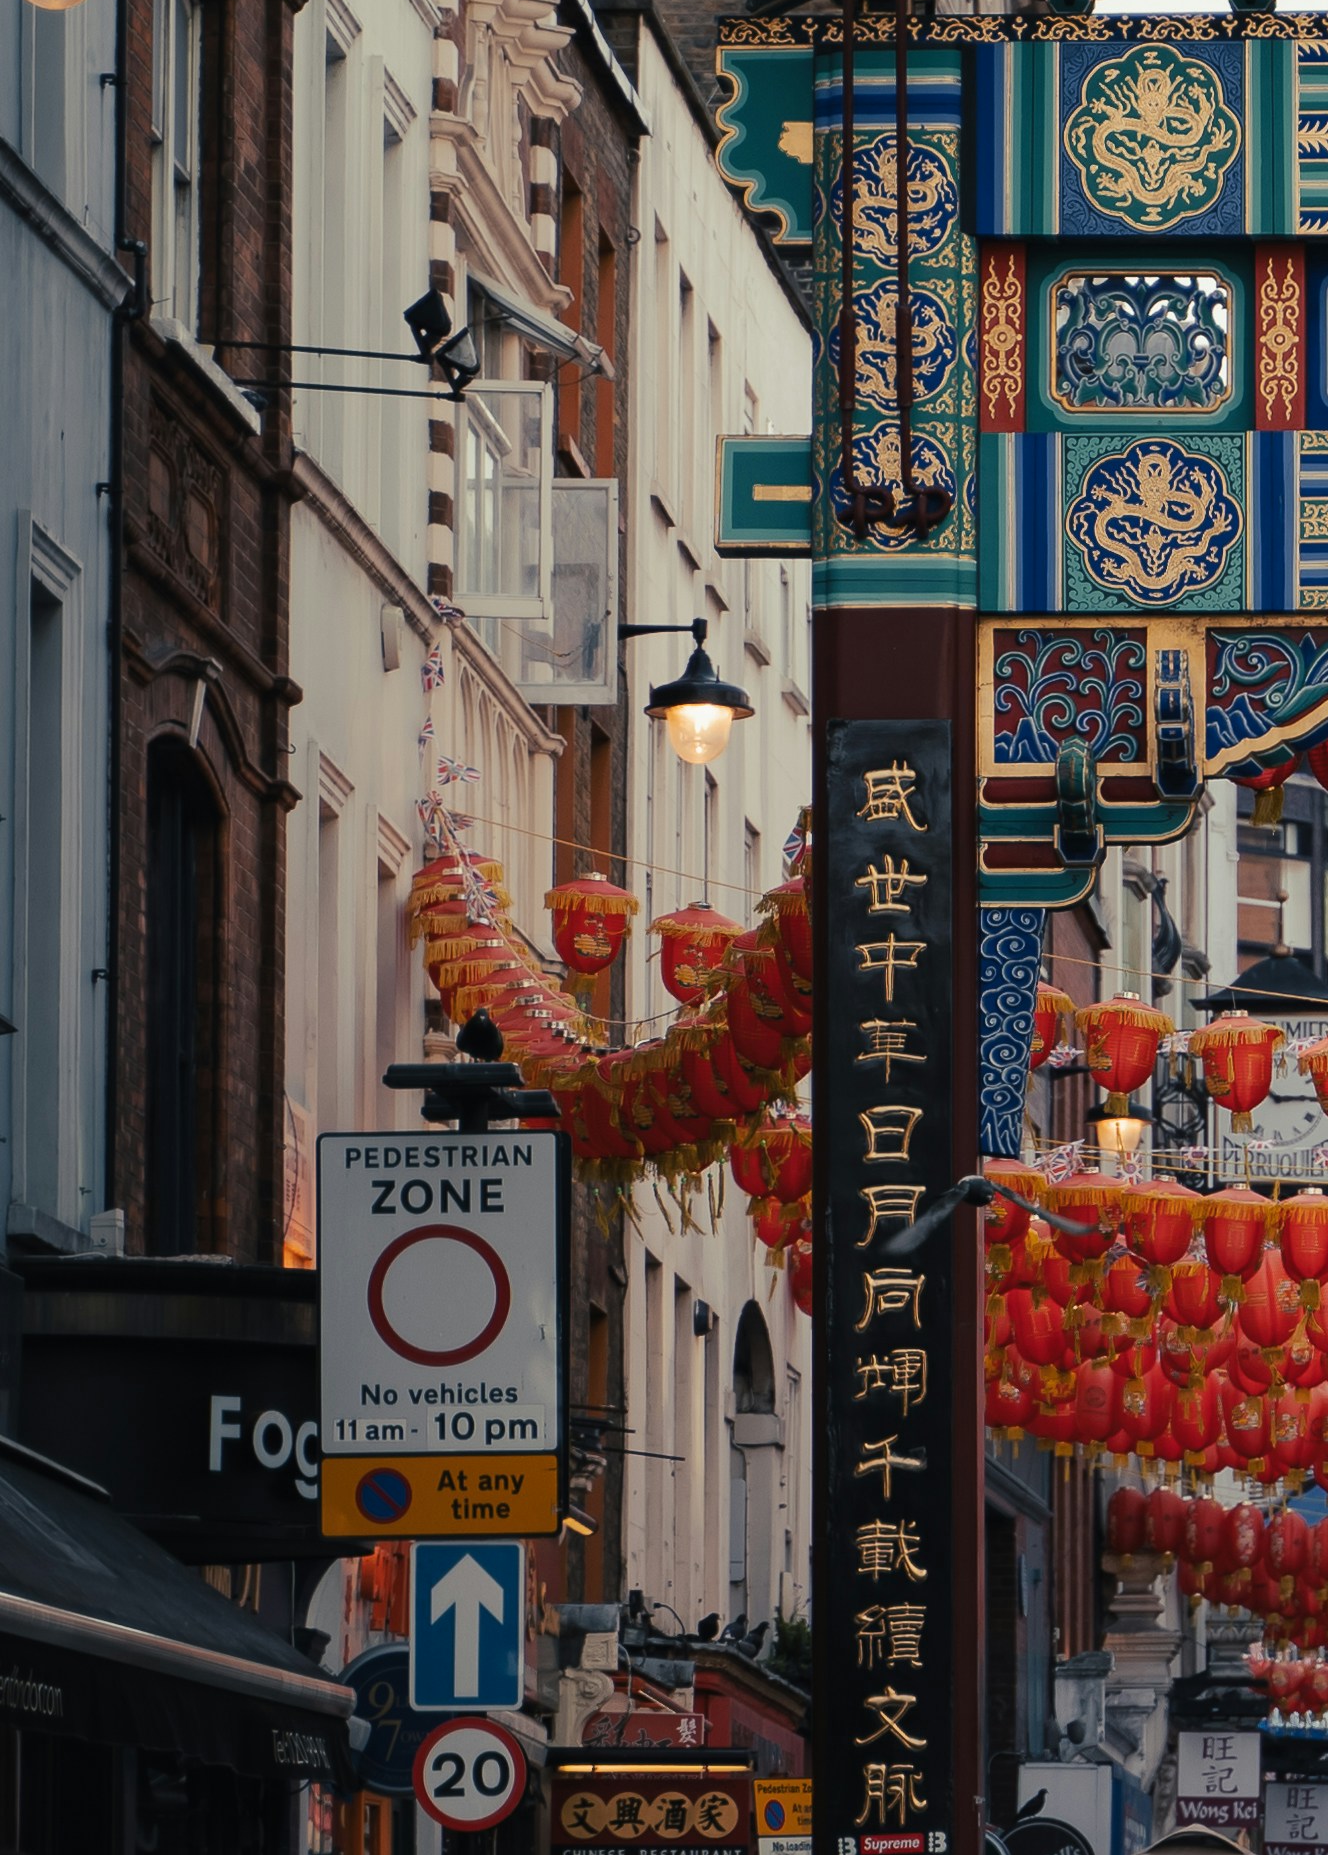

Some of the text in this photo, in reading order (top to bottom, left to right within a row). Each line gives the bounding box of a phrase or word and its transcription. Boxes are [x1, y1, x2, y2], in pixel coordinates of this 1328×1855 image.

[345, 1145, 532, 1169] PEDESTRIAN
[371, 1178, 504, 1213] ZONE
[361, 1382, 518, 1405] No vehicles
[336, 1419, 357, 1440] 11
[365, 1423, 404, 1440] am
[434, 1413, 475, 1440] 10
[485, 1417, 538, 1444] pm
[437, 1469, 524, 1496] At any
[452, 1496, 510, 1520] time
[431, 1752, 511, 1800] 20
[1202, 1735, 1239, 1795] 旺記
[565, 1794, 731, 1835] 文興酒家
[1179, 1800, 1257, 1824] Wong Kei
[1286, 1786, 1320, 1842] 旺記
[772, 1842, 785, 1851] No
[863, 1837, 920, 1853] Supreme
